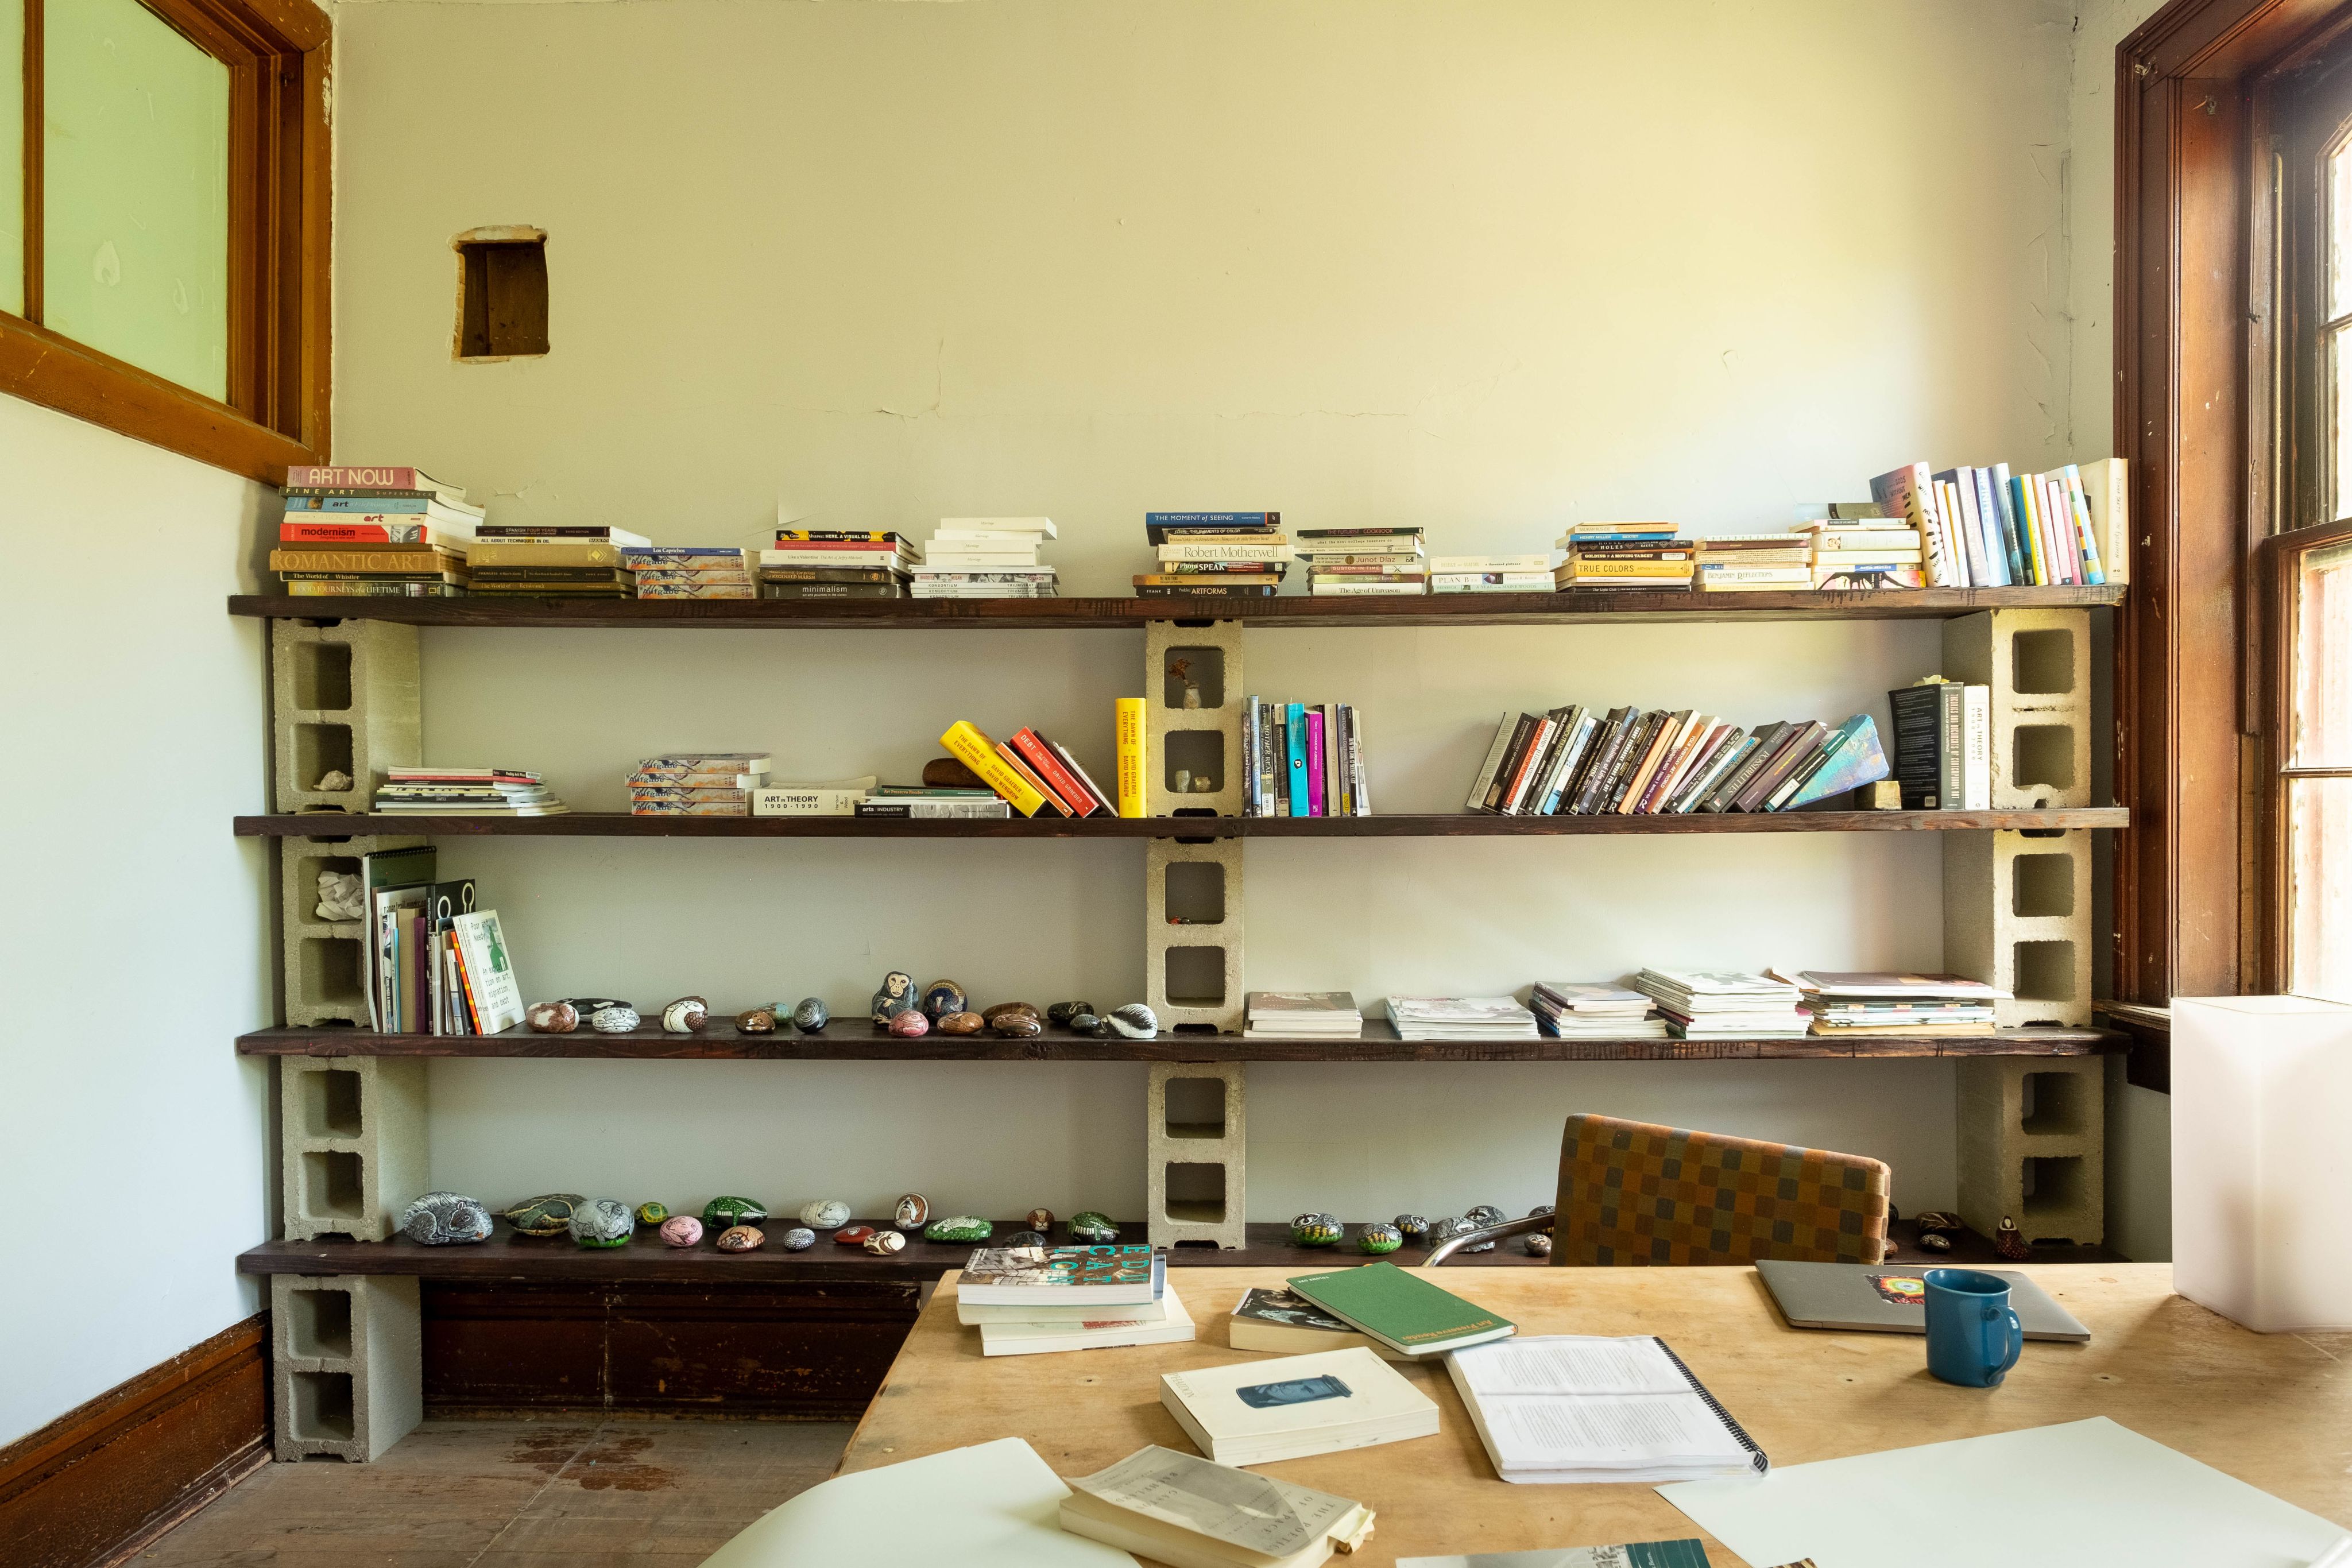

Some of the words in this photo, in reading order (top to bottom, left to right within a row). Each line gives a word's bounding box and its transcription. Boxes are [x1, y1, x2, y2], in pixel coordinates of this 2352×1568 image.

[309, 469, 343, 484] ART
[349, 470, 393, 486] NOW
[1895, 475, 1906, 485] GODS
[1889, 486, 1905, 497] WITHOUT
[1902, 491, 1911, 501] MEN
[1185, 547, 1217, 557] Robert
[1221, 546, 1278, 557] Motherwell
[275, 553, 380, 570] ROMANTIC
[387, 554, 426, 570] ART
[1551, 714, 1569, 745] SELF/IMAGE
[1623, 714, 1634, 729] Rose
[1514, 721, 1531, 752] PHENOMENOLOGY
[1539, 724, 1554, 749] BENJAMIN
[1560, 724, 1573, 744] ABOUT
[1615, 733, 1626, 746] The
[1769, 726, 1787, 744] GRAEBER
[1775, 731, 1789, 746] DAVID
[958, 734, 968, 744] THE
[966, 742, 980, 754] DAWN
[1020, 734, 1036, 751] DEBT
[1554, 743, 1564, 757] NOW
[954, 740, 980, 765] EVERYTHING
[1605, 744, 1620, 764] Politics
[1503, 757, 1515, 777] PERCEPTION
[1602, 762, 1610, 771] of
[1611, 762, 1622, 776] WORDS
[1669, 765, 1677, 775] ART
[1726, 749, 1770, 797] POSSIBILITIES
[991, 764, 1005, 776] DAVID
[1003, 774, 1022, 793] GRAEBER
[1597, 769, 1607, 781] Life
[1659, 773, 1672, 789] WORLD
[985, 769, 1000, 783] DAVID
[999, 781, 1019, 800] WENGROW
[1052, 770, 1065, 784] DAVID
[1064, 783, 1082, 804] GRAEBER
[1590, 779, 1601, 794] Itself
[1602, 783, 1610, 792] ART
[470, 922, 479, 931] Poor
[473, 933, 486, 942] Needy
[489, 985, 510, 998] migration,
[491, 1001, 499, 1009] and
[500, 997, 509, 1006] debt
[1114, 1471, 1179, 1504] BACHELARD
[1298, 1496, 1313, 1508] OF
[1311, 1502, 1336, 1520] THE
[1260, 1509, 1297, 1535] SPACE
[1266, 1521, 1312, 1552] POETICS
